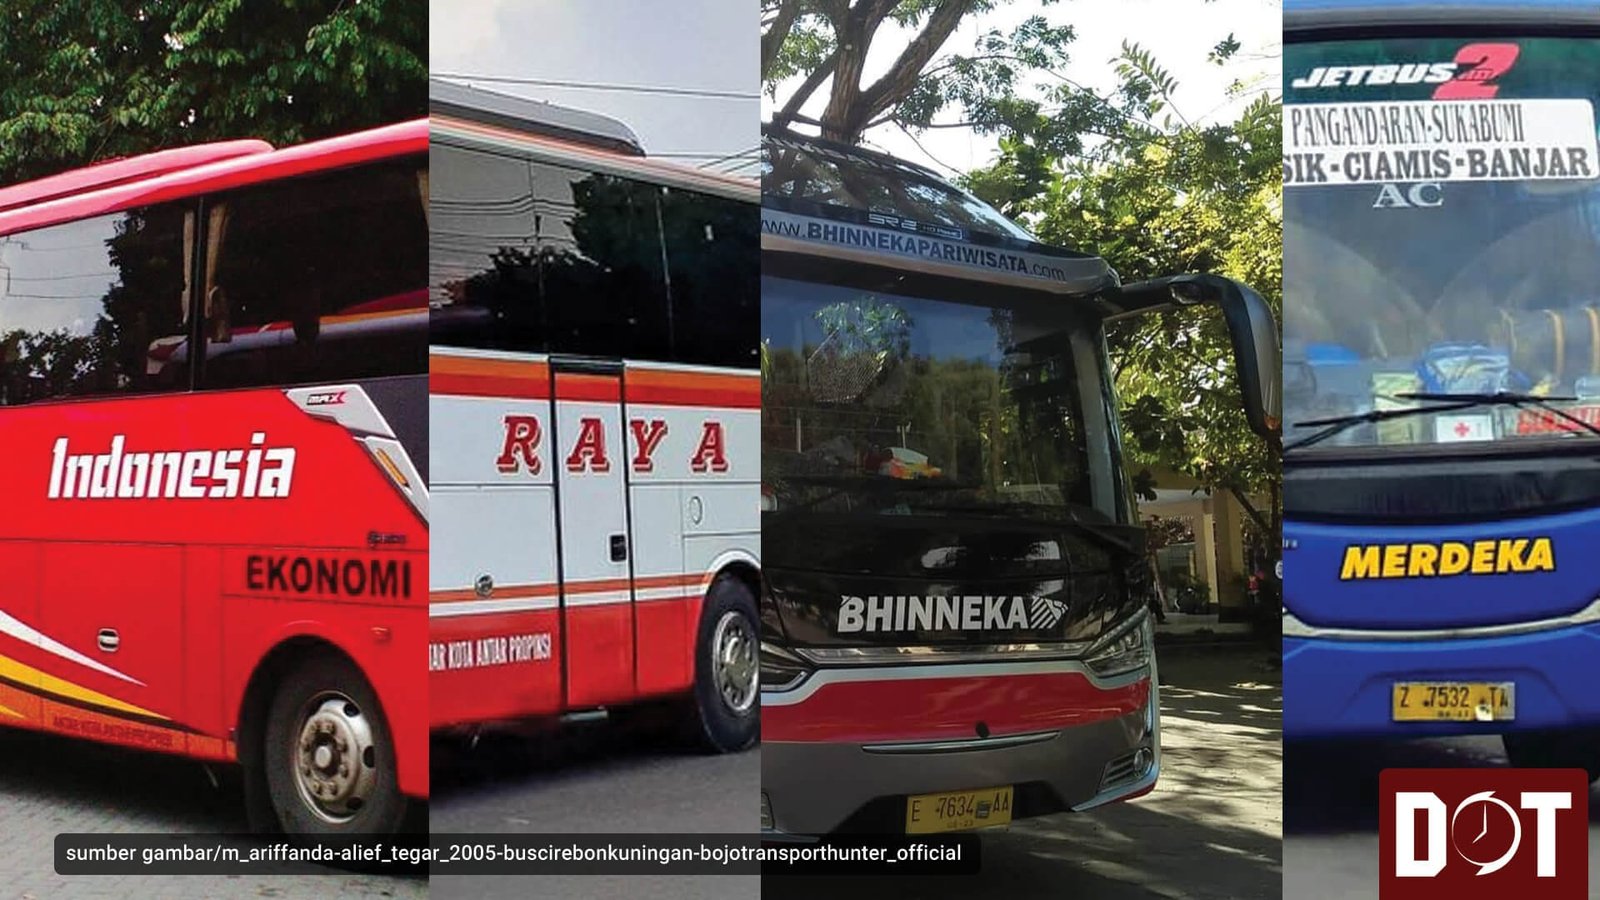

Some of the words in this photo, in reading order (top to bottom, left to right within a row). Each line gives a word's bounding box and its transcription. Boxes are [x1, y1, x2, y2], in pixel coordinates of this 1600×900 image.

[1372, 182, 1445, 209] AC
[761, 219, 1069, 282] ww.BHINNEKAPARIWISATA.com
[47, 431, 297, 500] Indonesia
[246, 555, 412, 599] EKONOMI
[1339, 537, 1556, 580] MERDEKA
[837, 595, 1029, 633] BHINNEKA
[1400, 686, 1410, 708] Z
[1427, 686, 1470, 708] 7532
[911, 800, 921, 822] E
[938, 794, 976, 819] 7634
[992, 791, 1010, 813] AA
